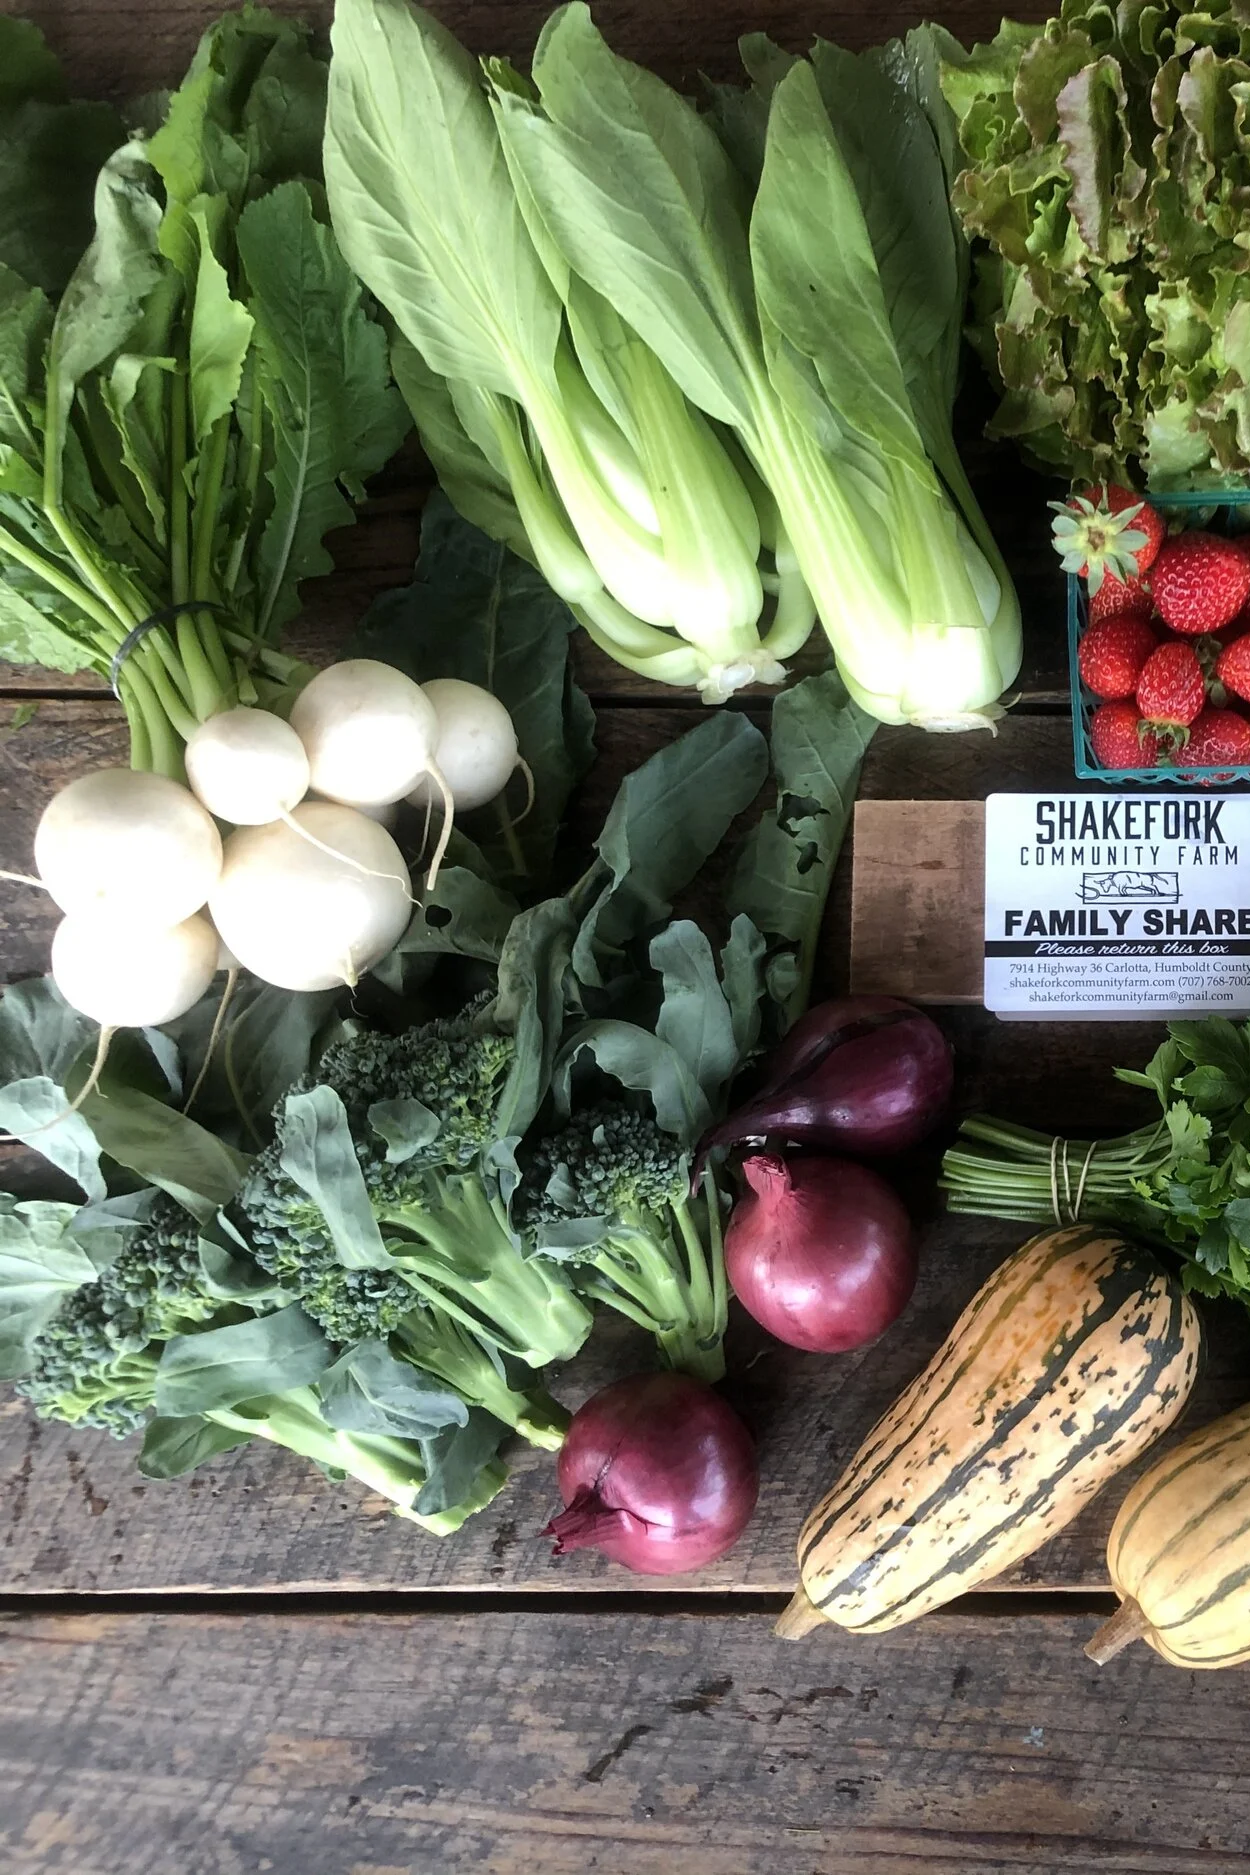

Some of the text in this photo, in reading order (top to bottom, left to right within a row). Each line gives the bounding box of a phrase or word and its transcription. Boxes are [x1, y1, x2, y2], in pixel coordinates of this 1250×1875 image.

[1036, 800, 1227, 845] SHAKEFORK
[1020, 845, 1239, 866] COMMUNITY FARM
[1004, 909, 1133, 936] FAMILY
[1035, 940, 1229, 955] Please return this box
[1009, 963, 1034, 974] 7914
[1037, 963, 1087, 976] Highway
[1089, 963, 1103, 974] 36
[1105, 962, 1152, 974] Carlotta,
[1154, 961, 1211, 973] Humboldt
[1009, 976, 1175, 990] shakeforkcommunityfarm.com
[1178, 975, 1205, 988] (707)
[1029, 990, 1234, 1004] shakeforkcommunityfarm@gmail.com
